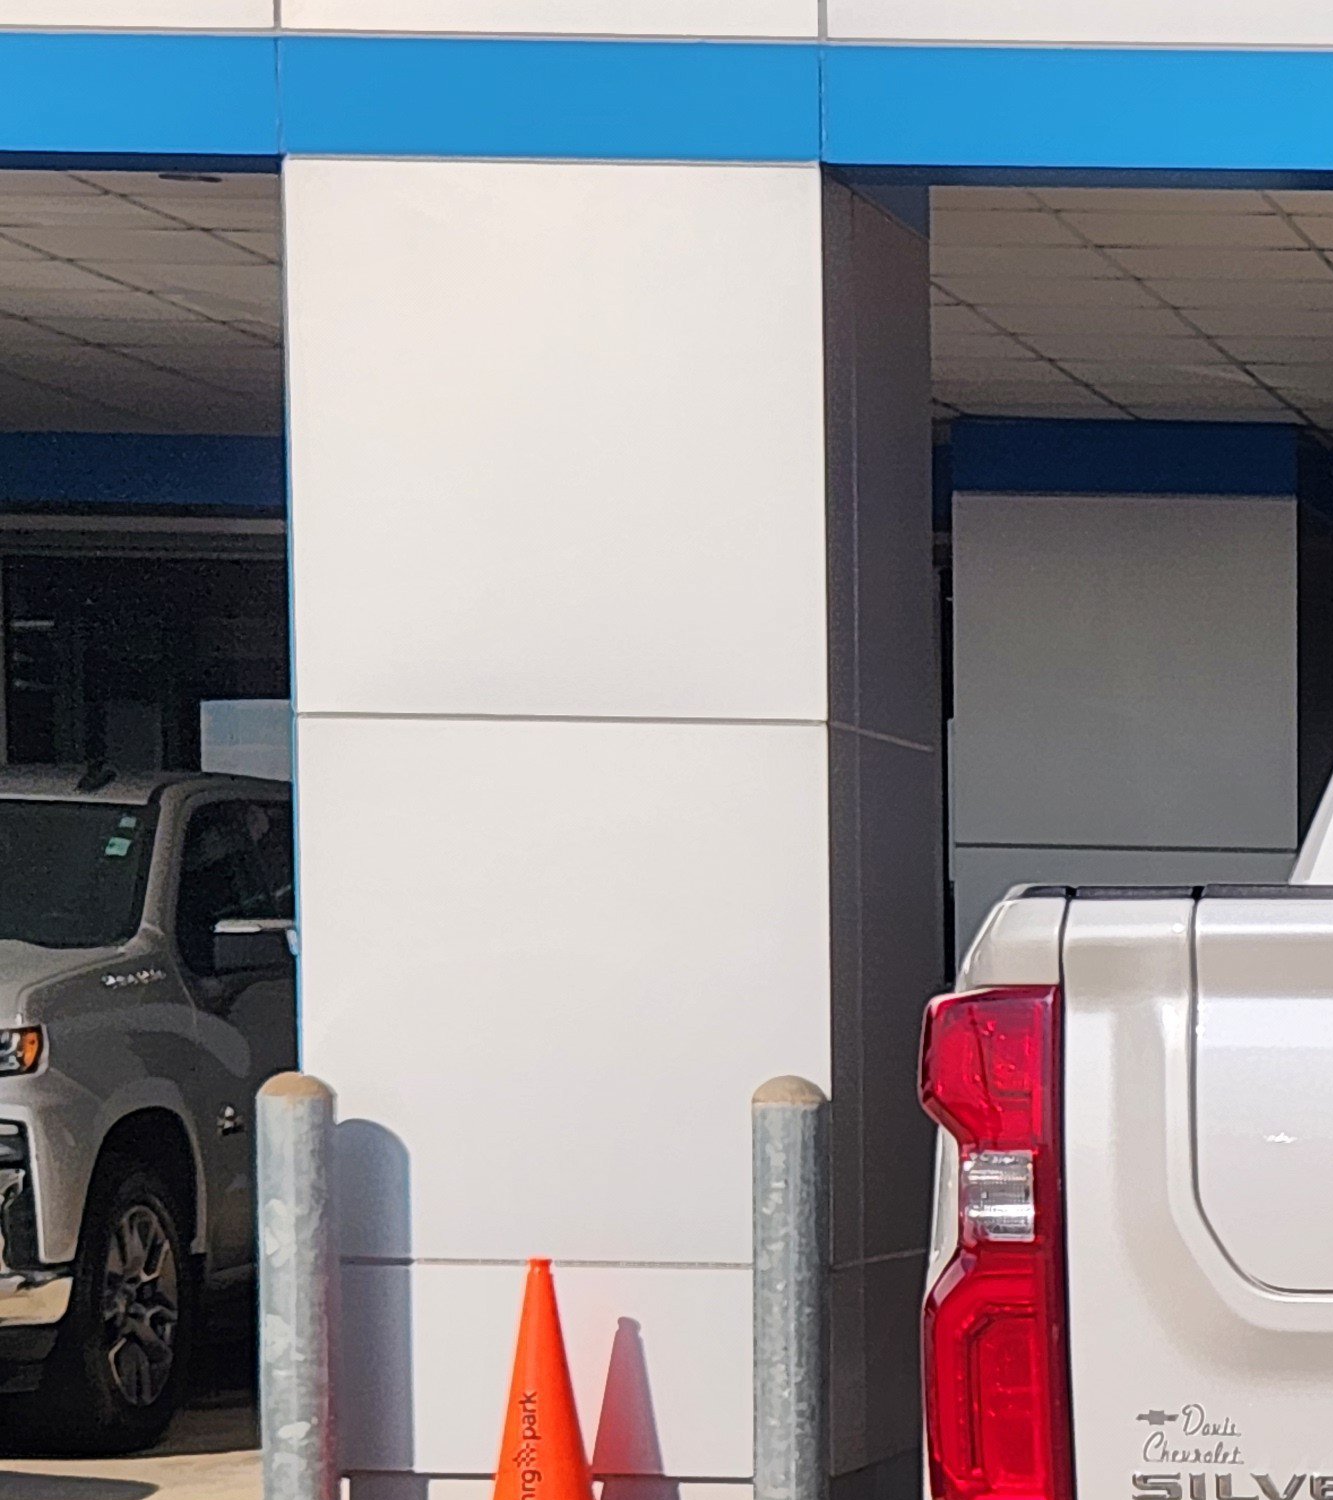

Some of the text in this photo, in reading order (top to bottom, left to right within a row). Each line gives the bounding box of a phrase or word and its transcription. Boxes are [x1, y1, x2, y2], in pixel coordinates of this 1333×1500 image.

[518, 1391, 542, 1440] park
[1182, 1403, 1241, 1436] Davis
[1143, 1431, 1244, 1464] Chevrolet
